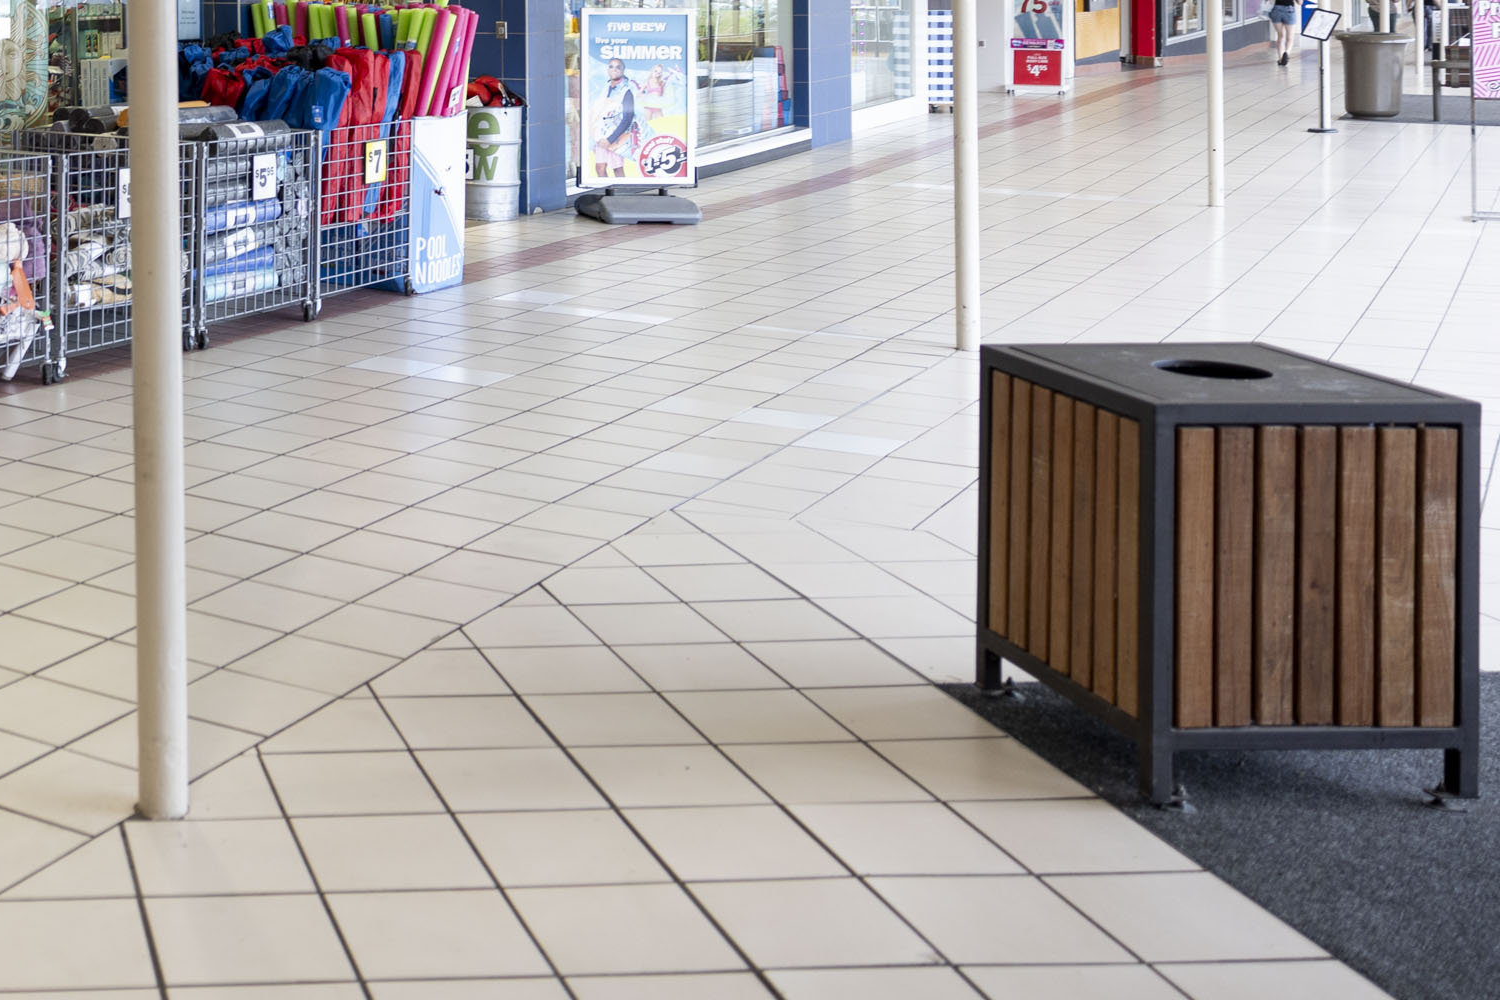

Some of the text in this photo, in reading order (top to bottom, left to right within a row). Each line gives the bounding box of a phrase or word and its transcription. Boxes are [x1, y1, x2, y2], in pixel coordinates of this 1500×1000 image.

[368, 149, 383, 175] $7
[415, 234, 448, 261] POOL
[414, 252, 462, 285] NOODLES
